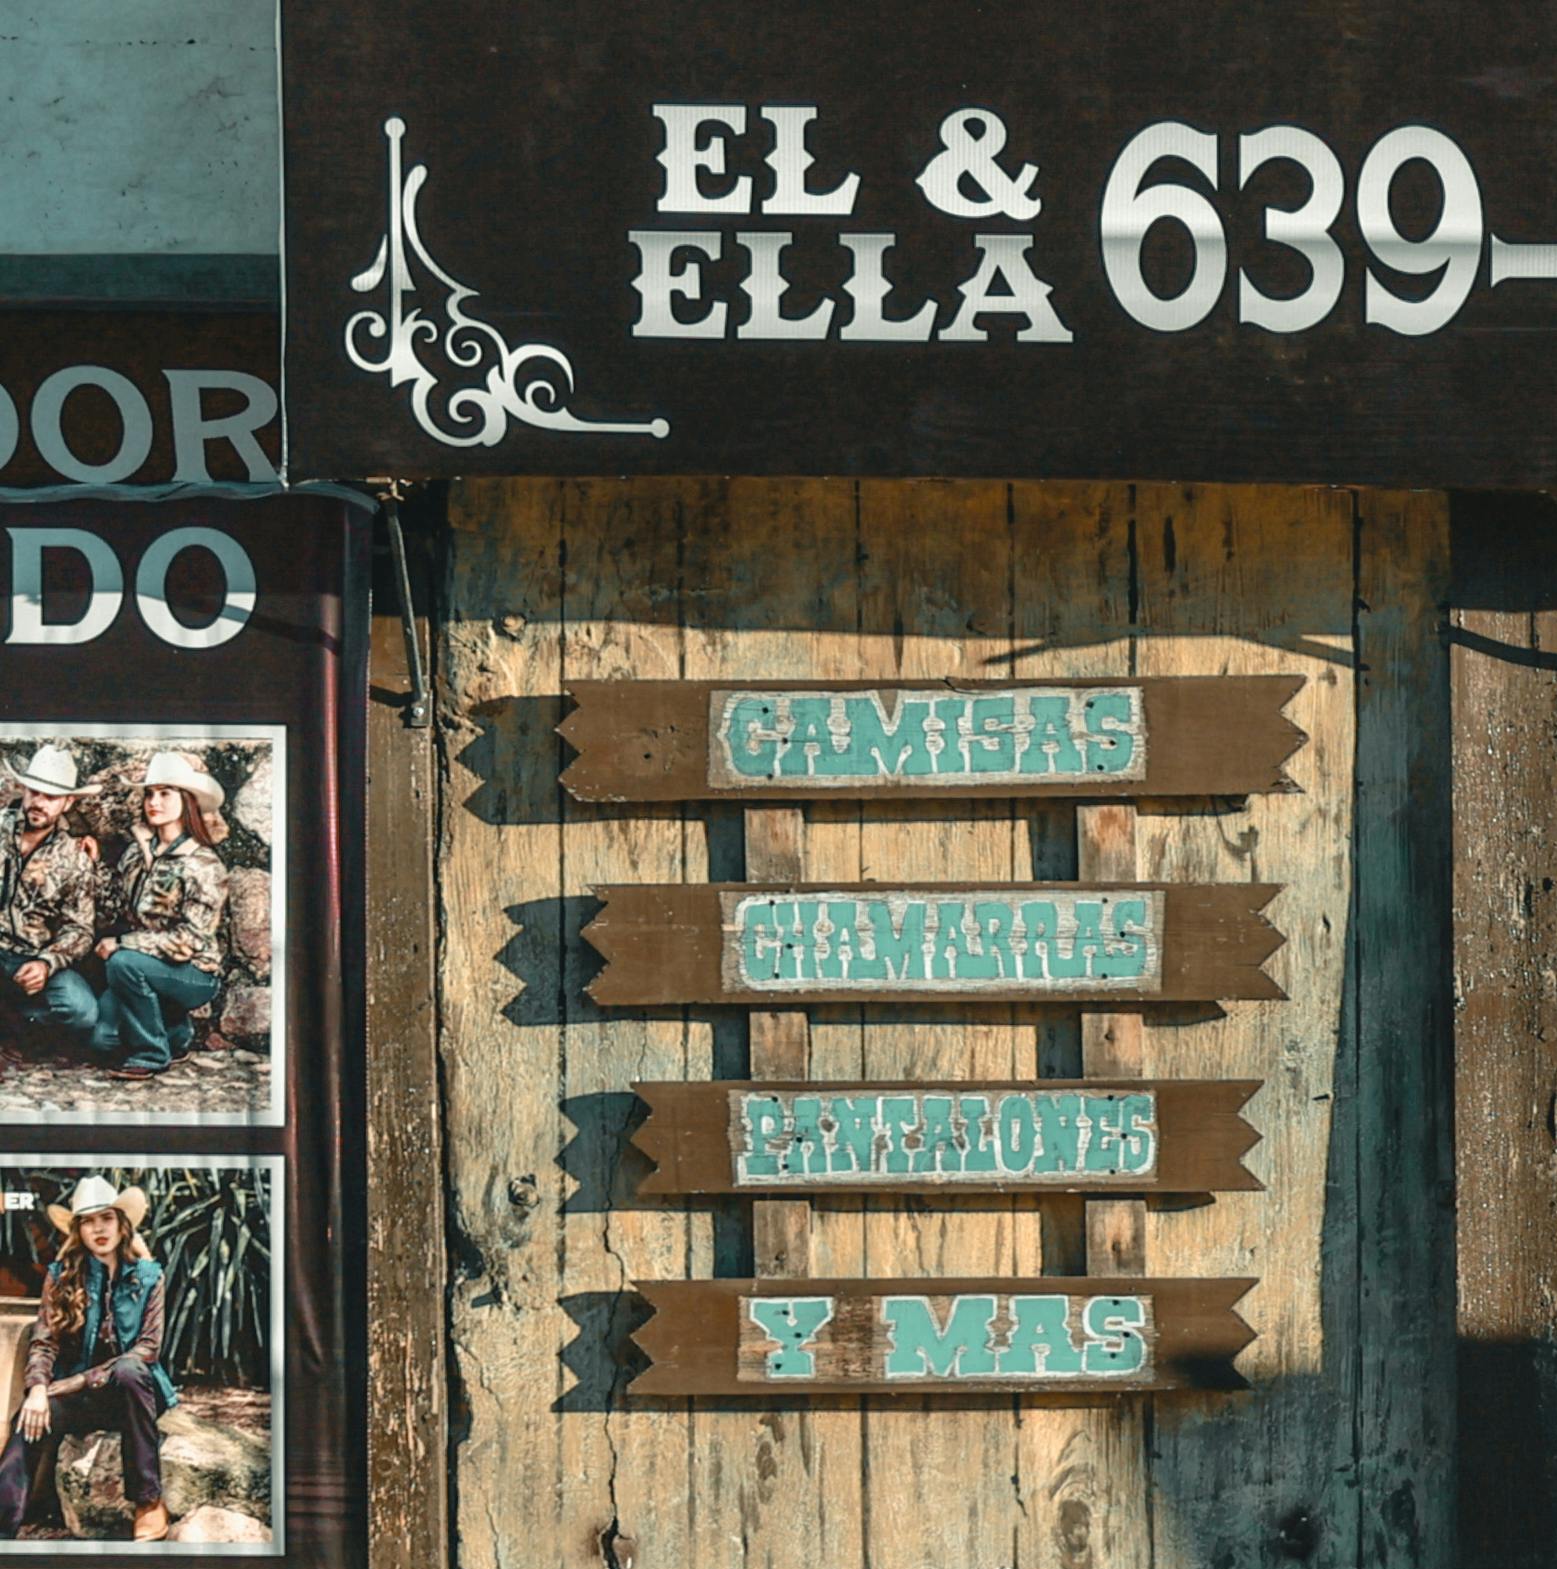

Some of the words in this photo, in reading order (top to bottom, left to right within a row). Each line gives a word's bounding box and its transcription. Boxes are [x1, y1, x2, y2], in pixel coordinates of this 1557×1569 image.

[652, 104, 861, 215] EL
[915, 107, 1042, 220] &
[628, 230, 1074, 343] ELLA
[0, 366, 280, 484] OR
[4, 526, 257, 649] DO
[731, 697, 1135, 777] CAMISAS
[744, 900, 1148, 980] CHAMARRAS
[743, 1095, 1152, 1176] PANTALONES
[750, 1296, 833, 1377] Y
[882, 1295, 1147, 1377] MAS
